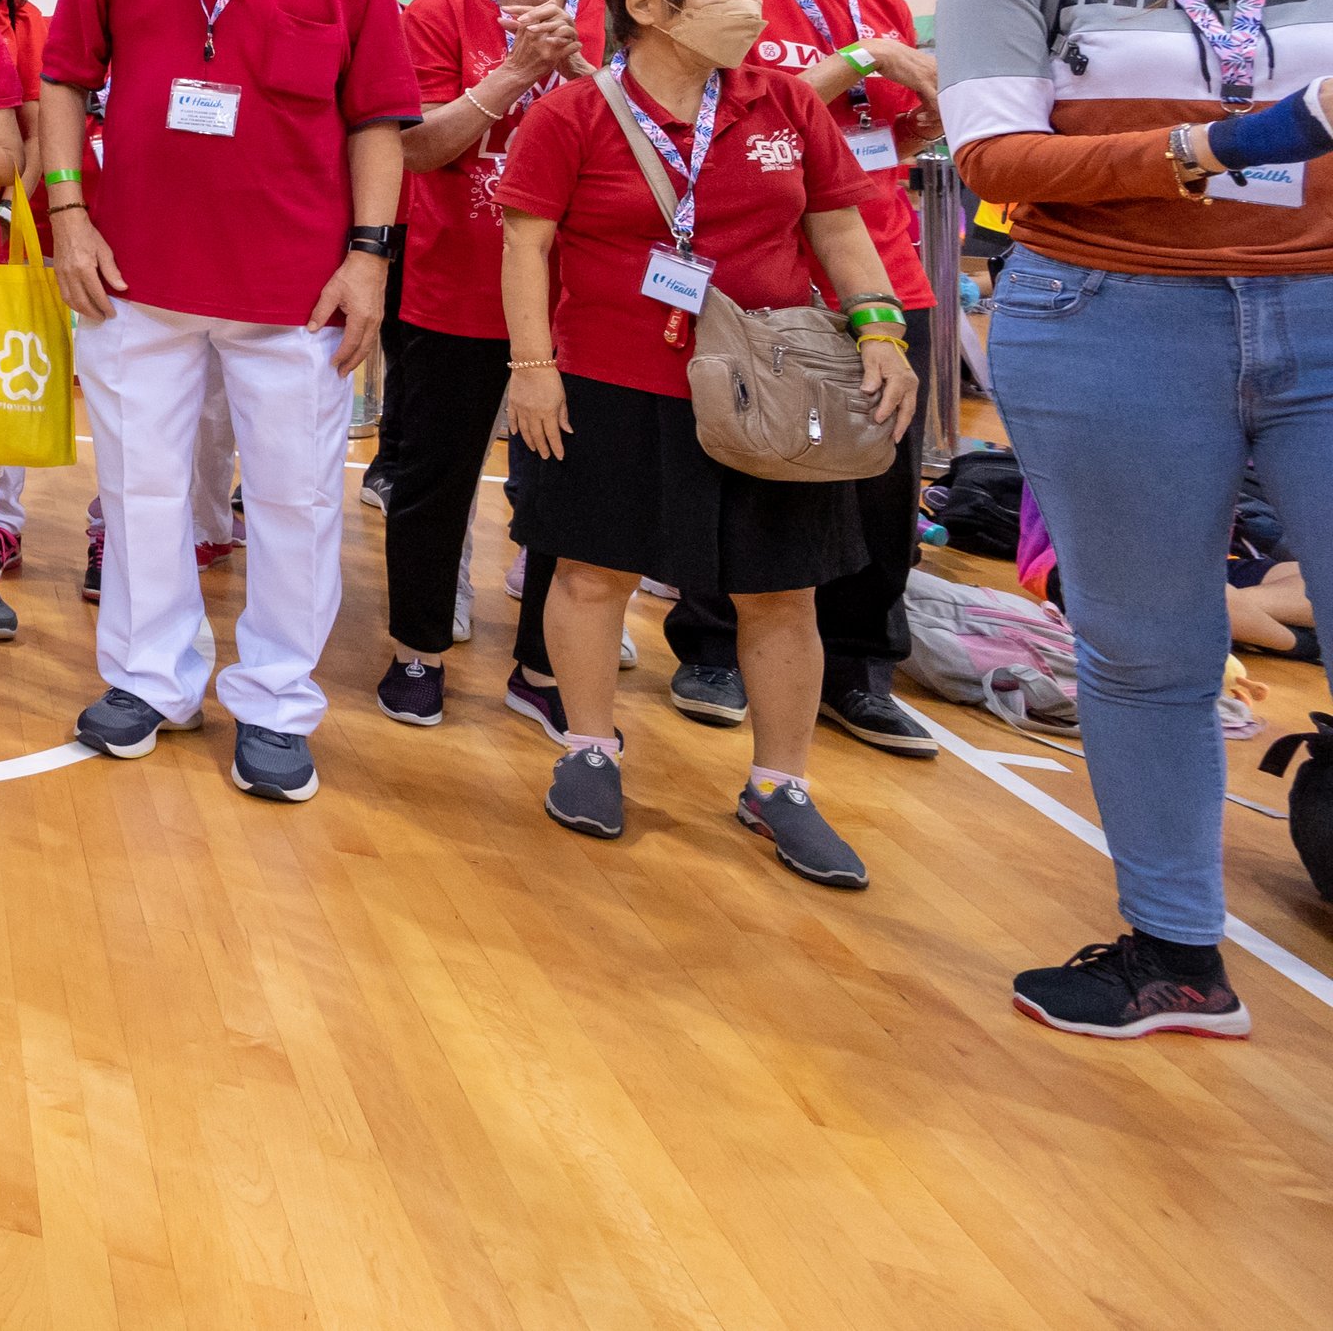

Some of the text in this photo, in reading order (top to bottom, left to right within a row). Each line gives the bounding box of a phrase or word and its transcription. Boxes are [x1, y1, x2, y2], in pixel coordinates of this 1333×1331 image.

[754, 140, 793, 164] 50
[1244, 169, 1293, 184] ealth
[666, 278, 699, 300] Health
